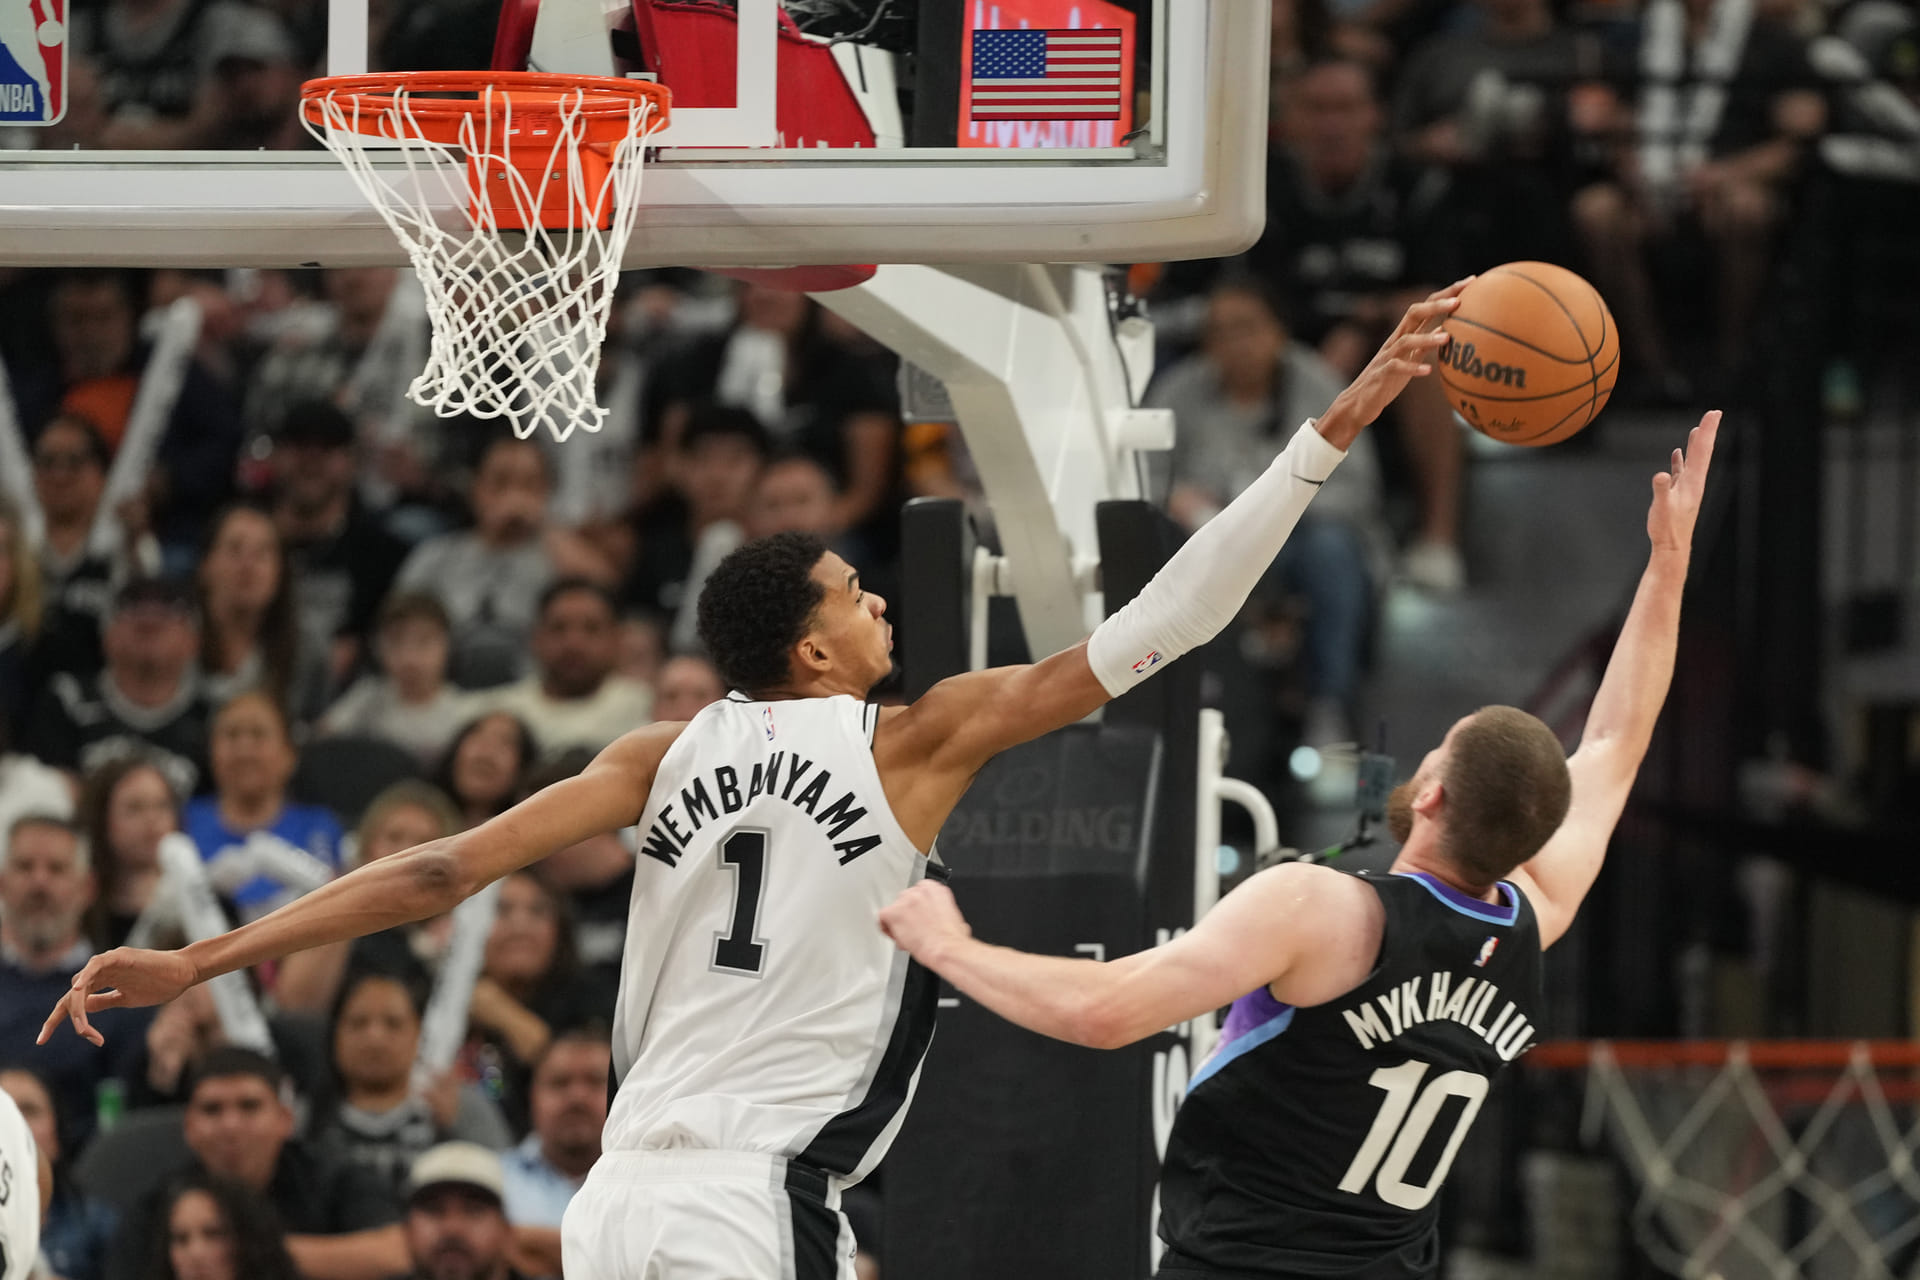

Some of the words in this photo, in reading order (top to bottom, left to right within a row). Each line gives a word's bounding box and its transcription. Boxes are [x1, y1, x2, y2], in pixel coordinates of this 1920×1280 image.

[0, 84, 35, 112] NBA
[641, 751, 882, 868] WEMBANYAMA
[943, 804, 1136, 853] PALDING
[708, 825, 771, 980] 1
[1342, 971, 1536, 1061] MYKHAILIU
[1337, 1059, 1490, 1211] 10
